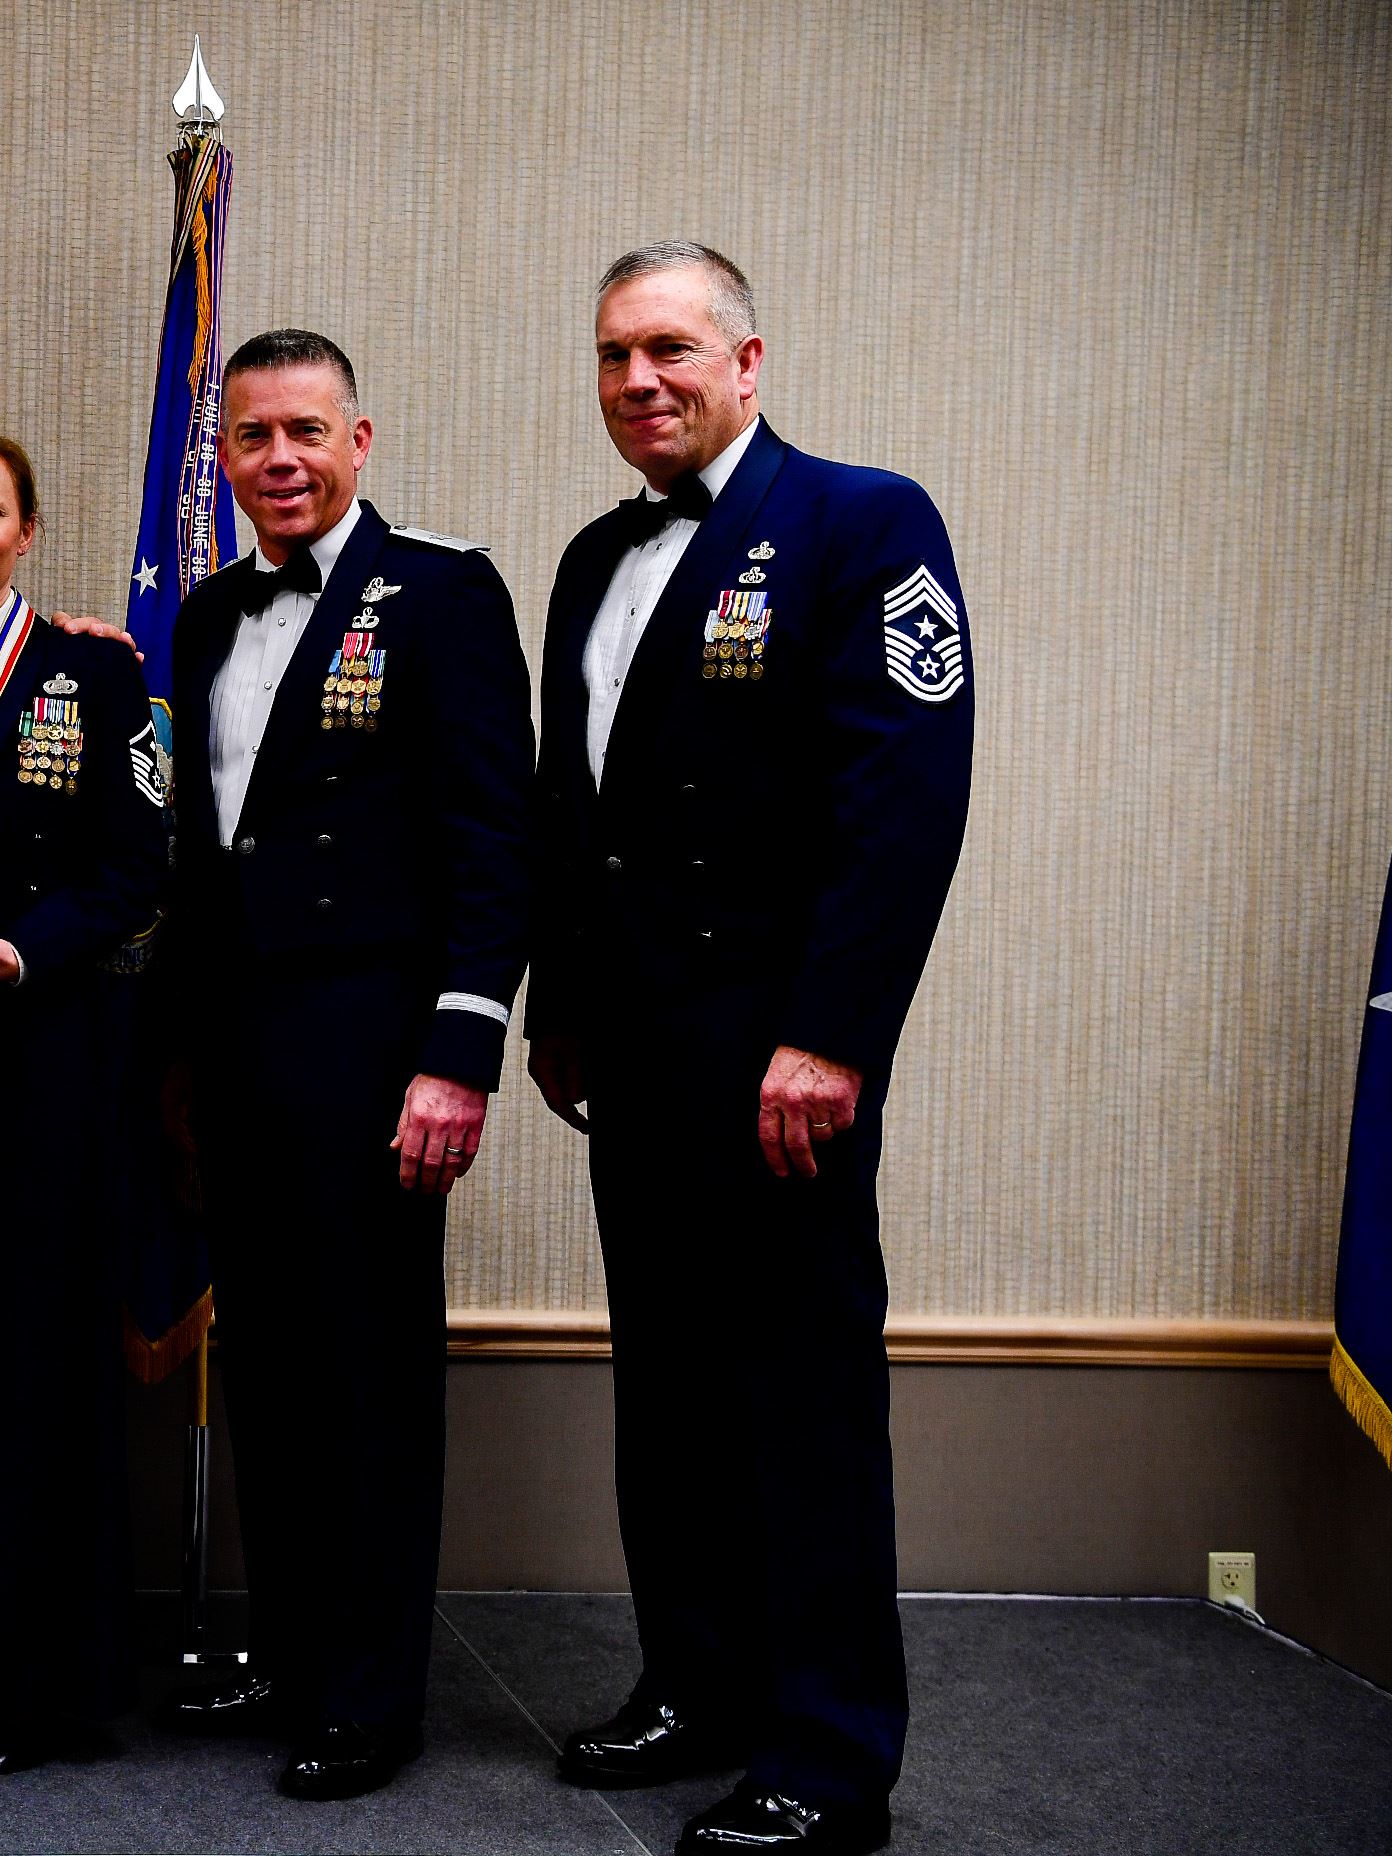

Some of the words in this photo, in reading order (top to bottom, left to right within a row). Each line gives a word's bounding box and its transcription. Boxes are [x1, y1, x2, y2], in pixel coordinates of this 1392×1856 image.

[202, 395, 219, 436] JULY
[196, 478, 212, 497] 30
[193, 505, 209, 549] JUNE
